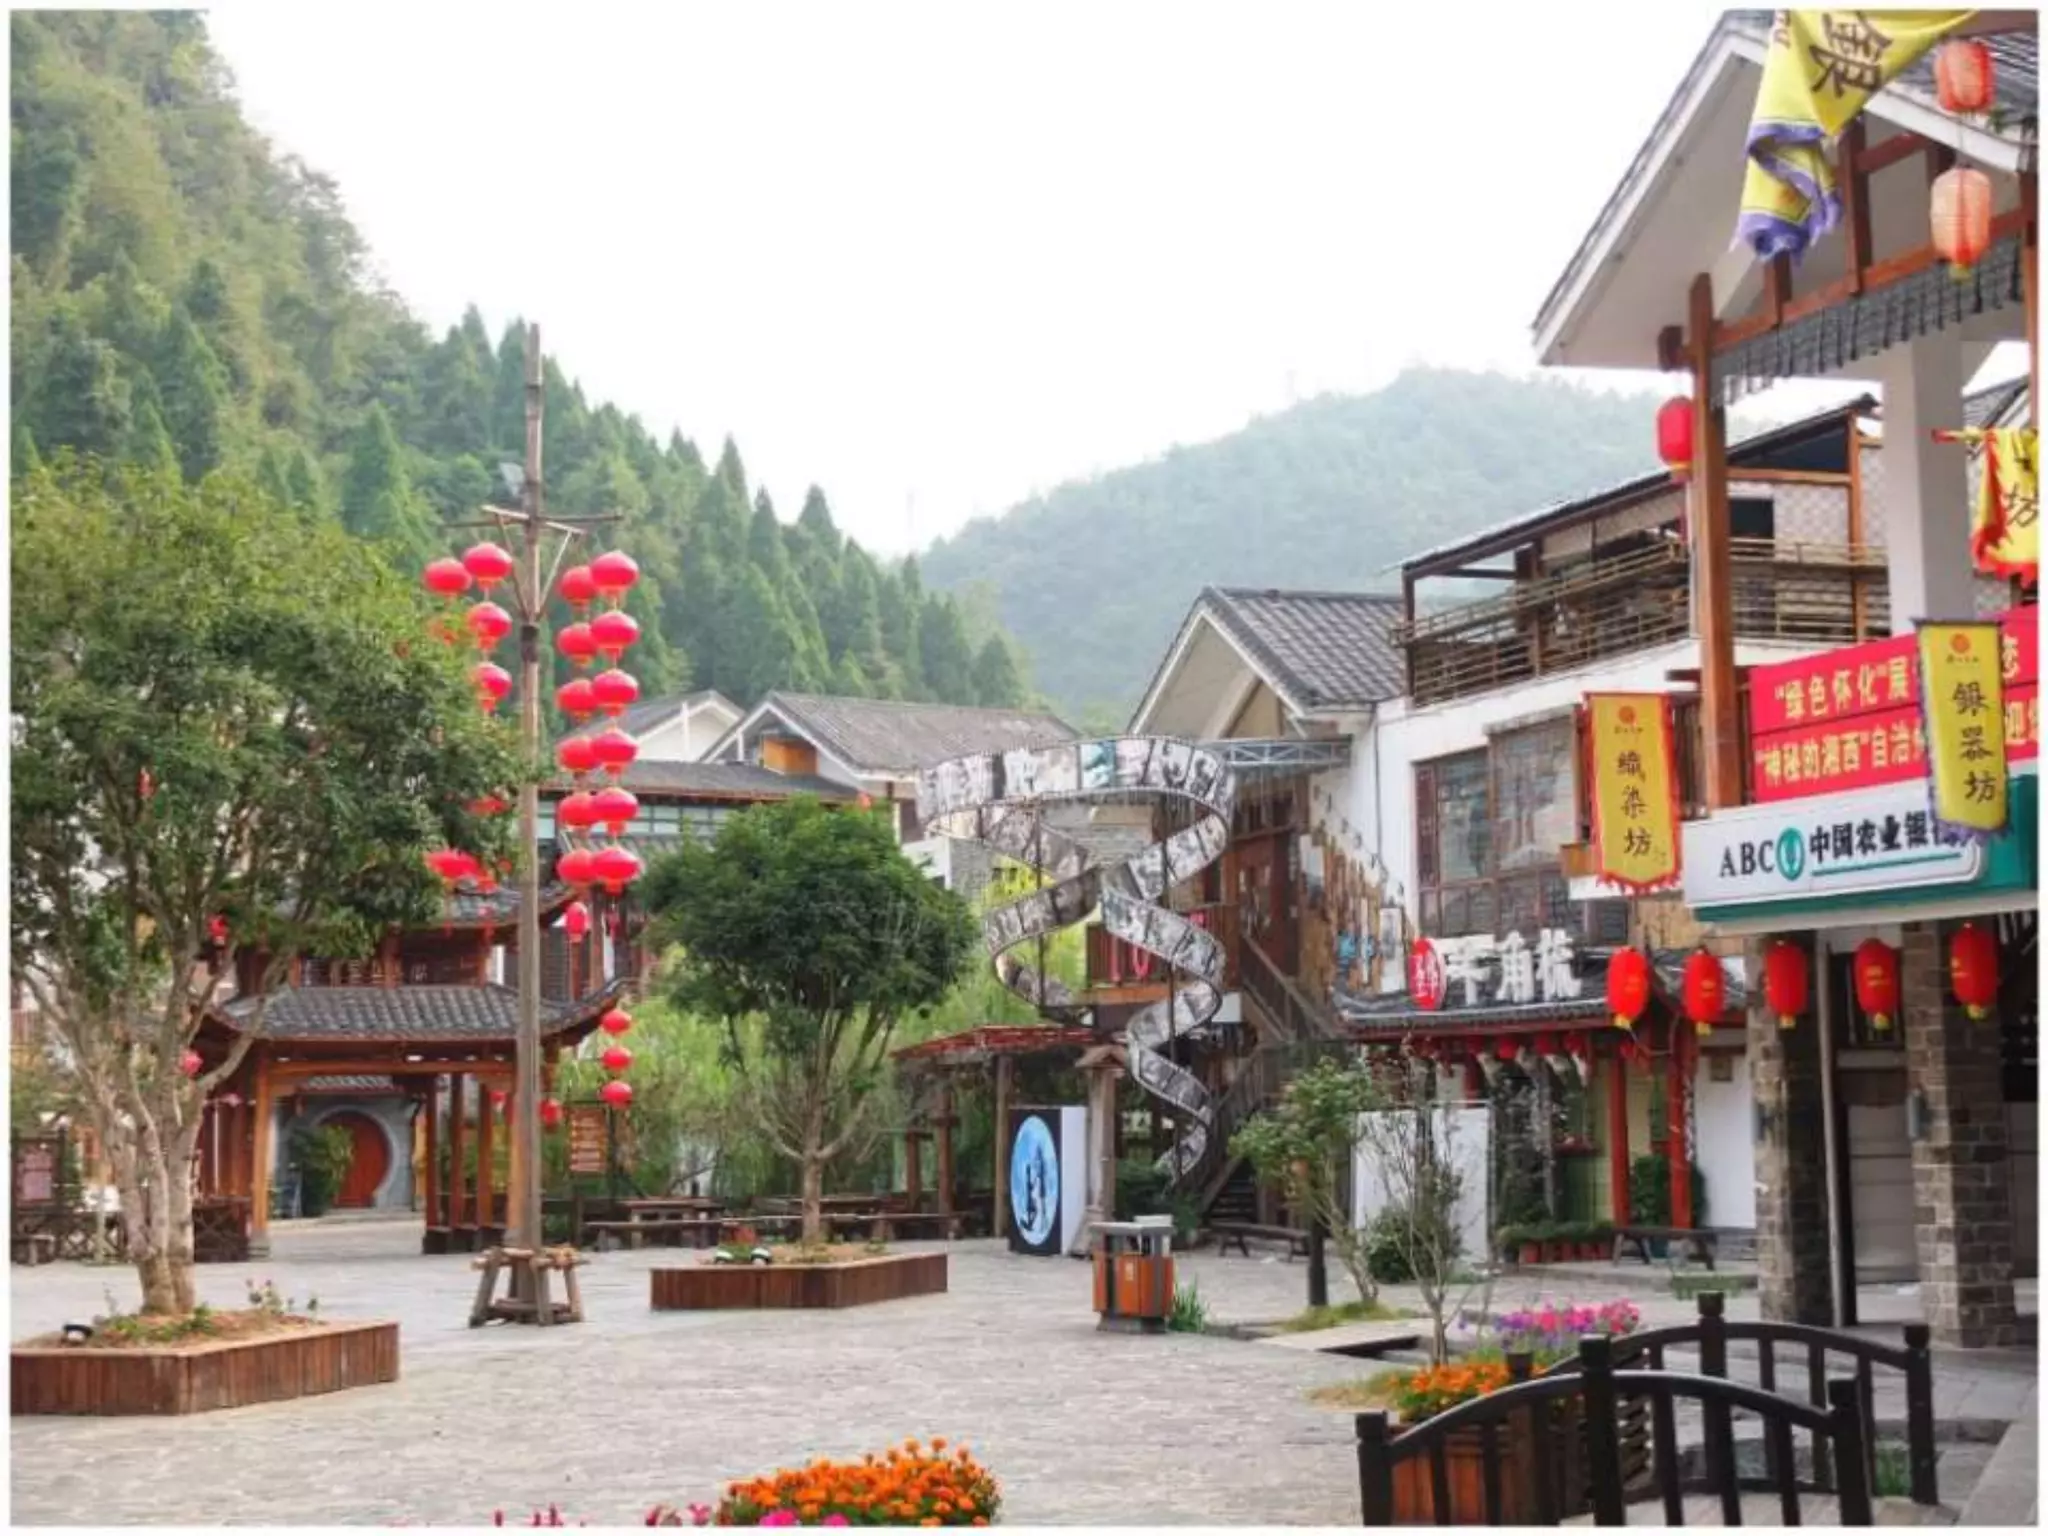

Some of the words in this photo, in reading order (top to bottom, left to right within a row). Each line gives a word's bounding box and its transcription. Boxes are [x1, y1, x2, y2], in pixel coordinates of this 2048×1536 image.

[1719, 839, 1775, 878] ABC
[1809, 809, 1964, 864] 中国农业银
